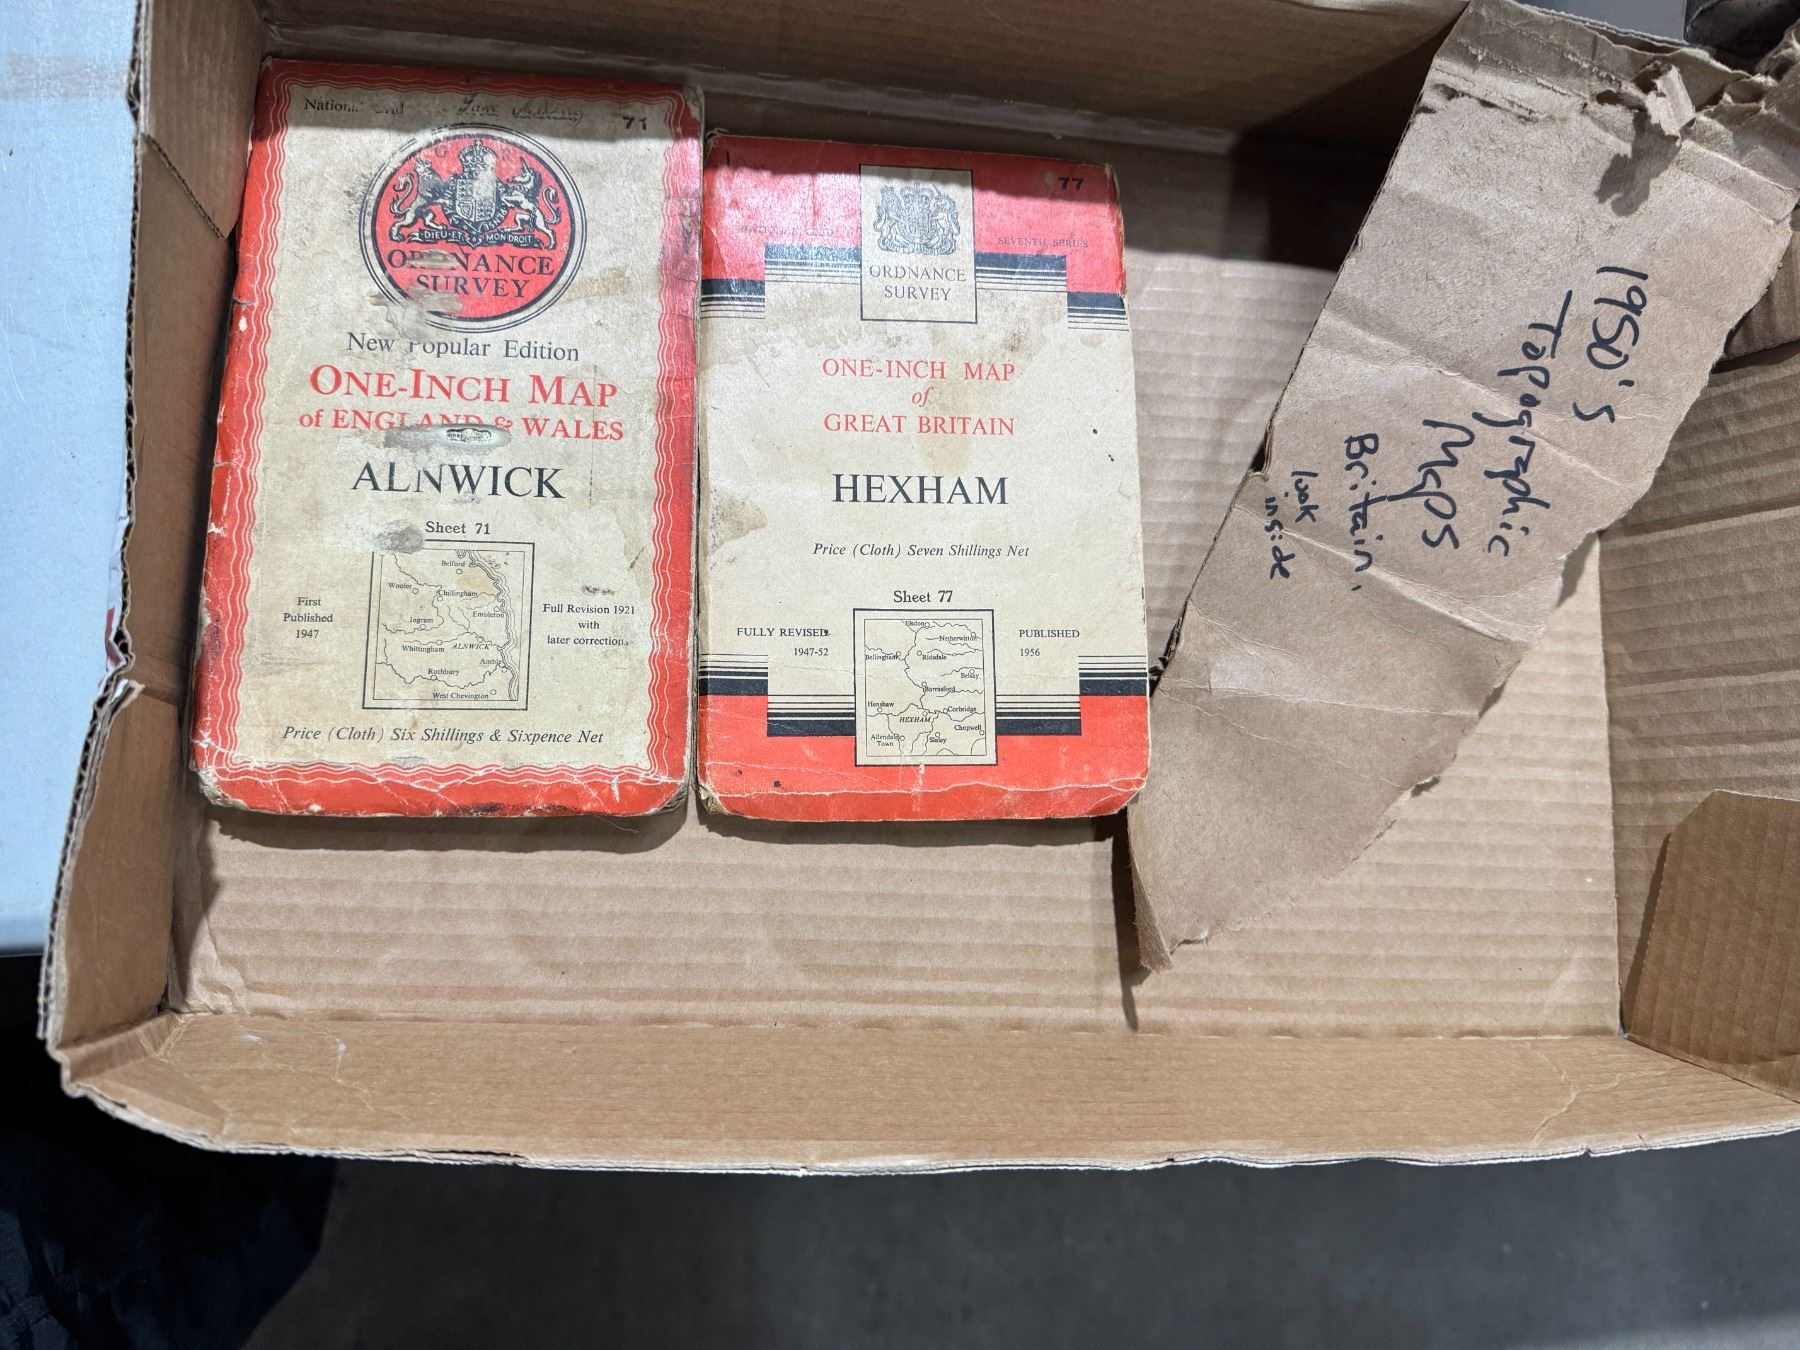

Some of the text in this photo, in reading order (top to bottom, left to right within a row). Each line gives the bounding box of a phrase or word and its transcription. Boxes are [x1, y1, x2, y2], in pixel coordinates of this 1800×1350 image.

[303, 97, 359, 113] Natio
[622, 115, 648, 130] 71
[1057, 177, 1084, 190] 77
[424, 231, 532, 243] DIEU ET MON DROIT
[869, 264, 967, 282] ORDNANCE
[416, 274, 530, 298] SURVEY
[884, 285, 952, 301] SURVEY
[347, 332, 395, 352] New
[504, 340, 580, 361] Edition
[822, 358, 1016, 382] ONE-INCH MAP
[310, 364, 619, 408] ONE-INCH MAP
[911, 386, 935, 407] of
[300, 408, 322, 429] of
[494, 415, 513, 431] &
[521, 417, 625, 441] WALES
[823, 413, 1015, 436] GREAT BRITAIN
[1472, 290, 1573, 557] Topographic
[351, 462, 566, 500] ALNWICK
[1386, 419, 1475, 550] Maps
[831, 473, 1009, 505] HEXHAM
[425, 520, 491, 535] Sheet 71
[813, 543, 1030, 559] Price (Cloth) Seven Shillings Net
[439, 589, 478, 598] Chillingham
[893, 590, 953, 603] Sheet 77
[296, 597, 322, 607] First
[542, 603, 635, 615] Full Revision 1921
[283, 612, 334, 623] Published
[578, 620, 600, 629] with
[296, 629, 320, 639] 1947
[547, 635, 570, 644] later
[737, 627, 829, 637] FULLY REVISED
[1019, 629, 1080, 639] PUBLISHED
[402, 645, 445, 653] Whittingham
[794, 647, 829, 657] 1947-52
[1020, 647, 1041, 657] 1956
[450, 692, 489, 700] Chevington
[281, 725, 604, 745] Price (Cloth) Six Shillings & Sixpence Net
